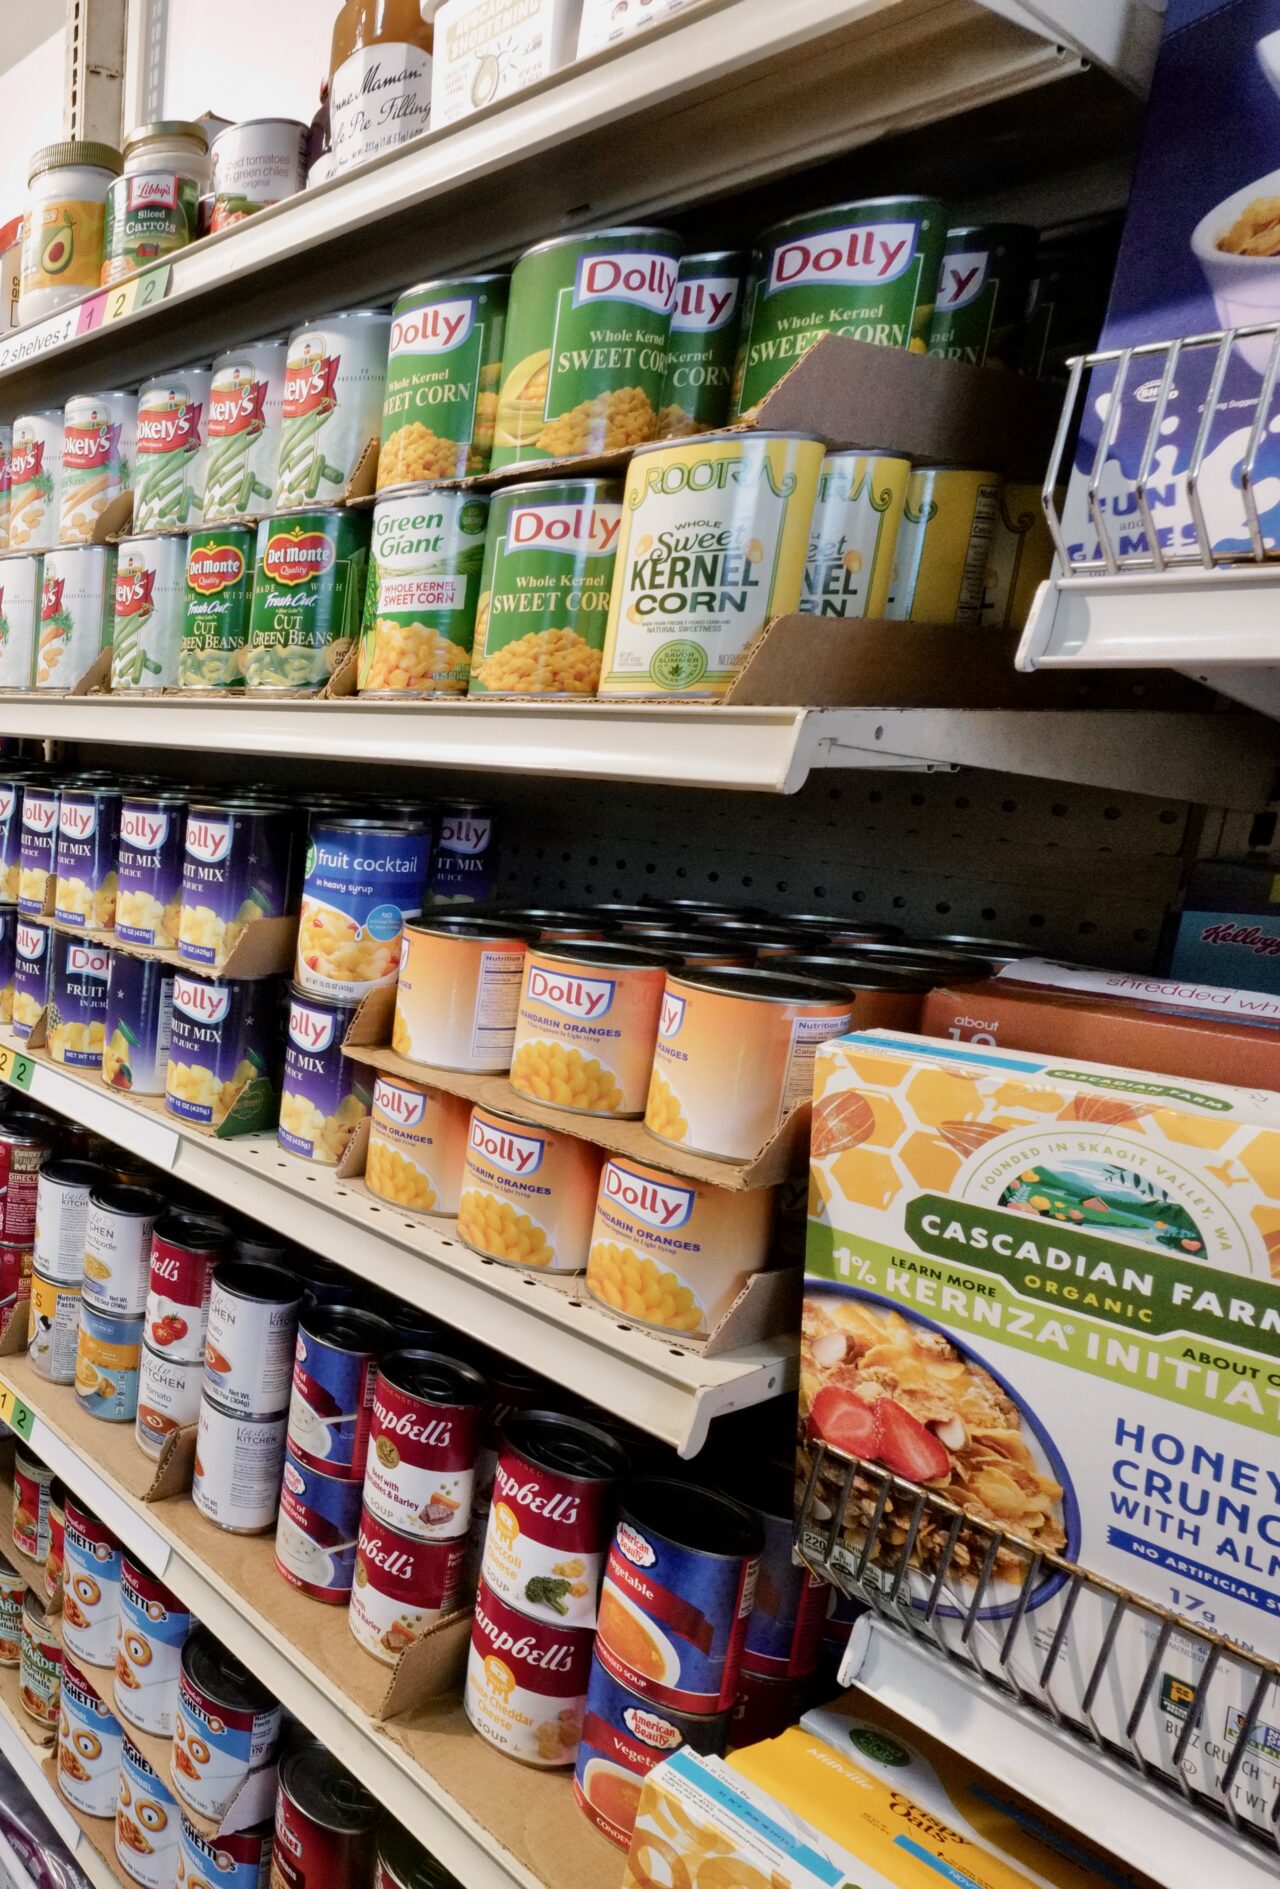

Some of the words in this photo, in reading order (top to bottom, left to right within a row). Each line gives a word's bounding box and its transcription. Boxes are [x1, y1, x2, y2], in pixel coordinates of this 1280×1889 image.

[377, 93, 431, 126] Filling
[246, 152, 291, 168] tomatoes
[234, 167, 261, 182] green
[263, 165, 289, 178] chiles
[137, 181, 171, 202] Libby's
[138, 208, 166, 220] Sliced
[126, 219, 177, 235] Carrots
[775, 231, 908, 283] Dolly
[586, 259, 676, 307] Dolly
[10, 331, 62, 364] shelves
[113, 294, 127, 318] 2
[141, 282, 155, 304] 2
[777, 313, 824, 332] Whole
[829, 304, 883, 322] Kernel
[390, 310, 465, 352] Dolly
[591, 329, 633, 344] Whole
[749, 328, 830, 367] SWEET
[558, 349, 636, 374] SWEET
[411, 368, 449, 386] Kernel
[673, 365, 732, 388] CORN
[415, 382, 471, 406] CORN
[376, 512, 444, 537] Green
[513, 508, 622, 551] Dolly
[674, 519, 723, 532] WHOLE
[380, 533, 445, 559] Giant
[650, 524, 746, 565] Sweet
[190, 561, 202, 574] Del
[203, 559, 241, 573] Monte
[267, 551, 285, 564] Del
[285, 548, 330, 563] Monte
[198, 576, 220, 586] Quality
[279, 564, 308, 576] Quality
[516, 576, 556, 588] Whole
[560, 574, 605, 587] Kernel
[630, 553, 760, 592] KERNEL
[223, 591, 253, 600] WITH
[310, 582, 342, 592] WITH
[384, 583, 414, 594] WHOLE
[415, 581, 456, 592] KERNEL
[264, 591, 292, 609] Fresh
[383, 594, 414, 607] SWEET
[417, 592, 455, 604] CORN
[493, 592, 561, 615] SWEET
[634, 591, 748, 616] CORN
[193, 621, 217, 635] CUT
[273, 614, 303, 630] CUT
[205, 634, 245, 649] BEANS
[252, 630, 287, 646] GREEN
[288, 629, 333, 646] BEANS
[33, 836, 55, 849] MIX
[69, 844, 92, 857] MIX
[135, 853, 162, 869] MIX
[317, 849, 350, 871] fruit
[353, 856, 418, 874] cocktail
[197, 867, 225, 883] MIX
[323, 879, 346, 894] heavy
[348, 881, 374, 896] syrup
[20, 962, 40, 976] MIX
[67, 982, 105, 998] FRUIT
[531, 972, 606, 1016] Dolly
[1105, 976, 1232, 1006] shredded
[563, 1022, 622, 1038] ORANGES
[798, 1019, 838, 1031] Nutrition
[953, 1013, 1000, 1033] about
[192, 1025, 222, 1044] MIX
[16, 1062, 27, 1082] 2
[297, 1054, 325, 1075] MIX
[374, 1080, 419, 1121] Dolly
[1053, 1070, 1164, 1093] CASCADIAN
[1168, 1090, 1223, 1110] FARM
[393, 1131, 434, 1146] ORANGES
[472, 1119, 535, 1172] Dolly
[980, 1145, 1042, 1194] FOUNDED
[1048, 1142, 1069, 1154] IN
[1077, 1142, 1149, 1168] SKAGIT
[507, 1178, 552, 1197] ORANGES
[606, 1168, 684, 1225] Dolly
[636, 1229, 701, 1252] ORANGES
[920, 1214, 1153, 1298] CASCADIAN
[890, 1255, 942, 1281] LEARN
[946, 1274, 997, 1299] MORE
[57, 1301, 76, 1310] Facts
[1024, 1275, 1154, 1324] ORGANIC
[833, 1246, 877, 1285] 1%
[1087, 1331, 1280, 1421] INITIA
[1182, 1347, 1261, 1380] ABOUT
[145, 1383, 173, 1403] Tomato
[0, 1392, 7, 1409] 1
[16, 1408, 28, 1428] 2
[236, 1434, 277, 1444] KITCHEN
[393, 1493, 420, 1512] Barley
[1112, 1460, 1280, 1548] CRUNC
[1110, 1491, 1201, 1547] WITH
[487, 1567, 510, 1593] SOUP
[1132, 1541, 1159, 1560] NO
[1165, 1556, 1259, 1603] ARTIFICIAL
[623, 1668, 647, 1688] SOUP
[489, 1694, 535, 1727] Cheddar
[476, 1717, 508, 1745] SOUP
[631, 1712, 677, 1740] American
[634, 1724, 672, 1748] Beauty
[806, 1747, 873, 1791] Millville
[1246, 1791, 1268, 1813] WT
[889, 1791, 974, 1847] Crispy
[889, 1802, 947, 1844] Oats
